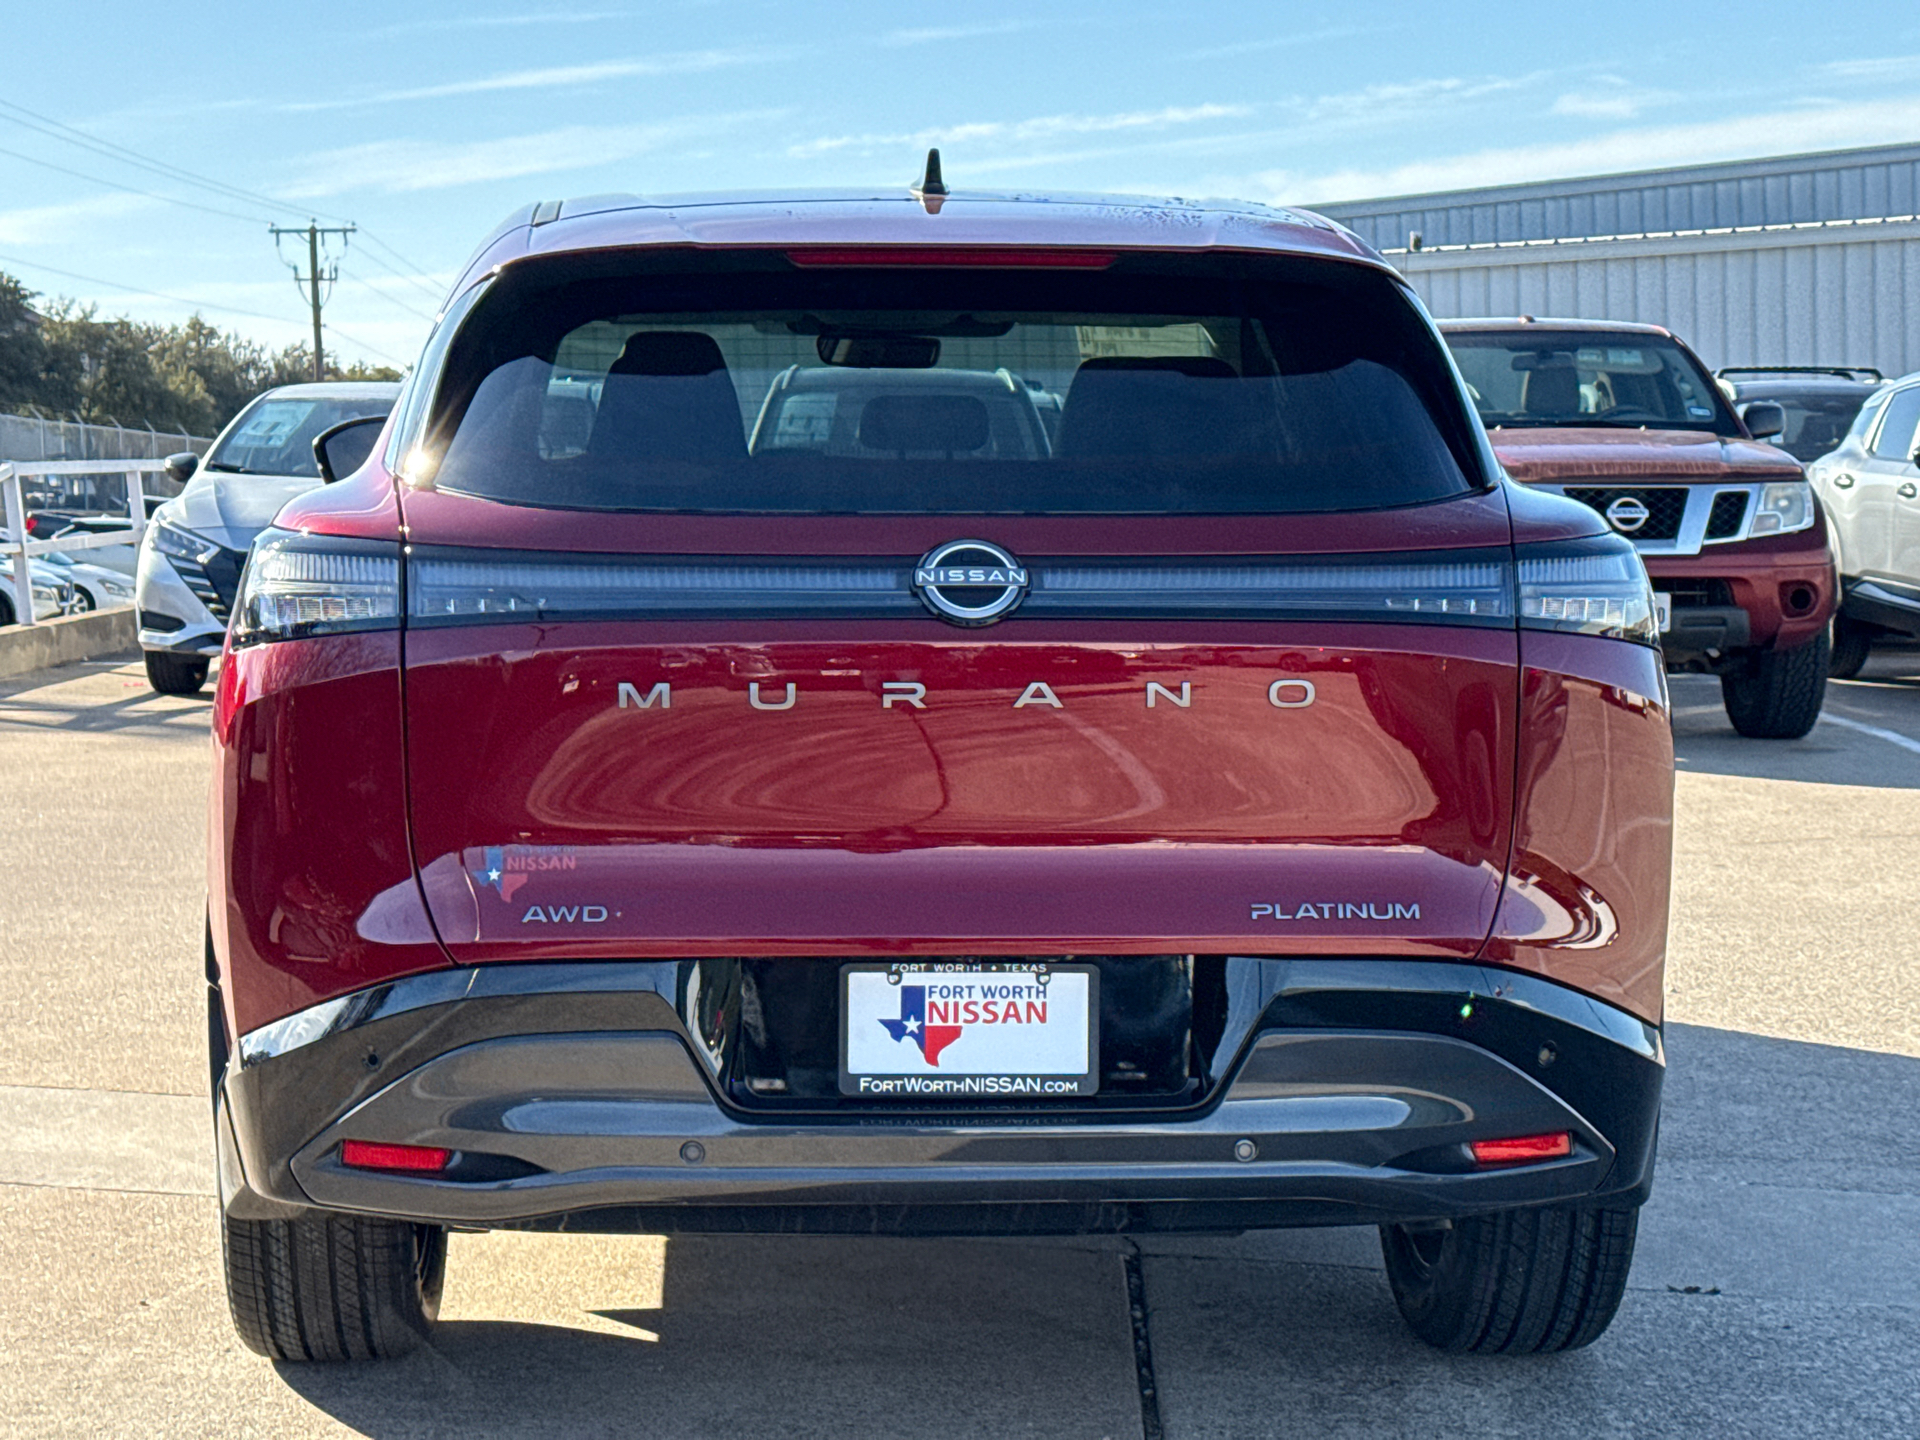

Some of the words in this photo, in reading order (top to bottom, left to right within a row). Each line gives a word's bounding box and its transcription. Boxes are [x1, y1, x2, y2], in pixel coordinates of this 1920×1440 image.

[1611, 508, 1645, 516] NISSAN
[918, 570, 1025, 582] NISSAN
[617, 680, 1316, 710] MURANO
[506, 855, 577, 871] NISSAN
[521, 905, 608, 923] AWD
[1250, 903, 1421, 920] PLATINUM
[891, 963, 926, 973] FORT
[934, 963, 982, 973] WORTH
[1004, 963, 1047, 973] TEXAS
[928, 985, 976, 999] FORT
[981, 985, 1047, 999] WORTH
[927, 1001, 1048, 1024] NISSAN
